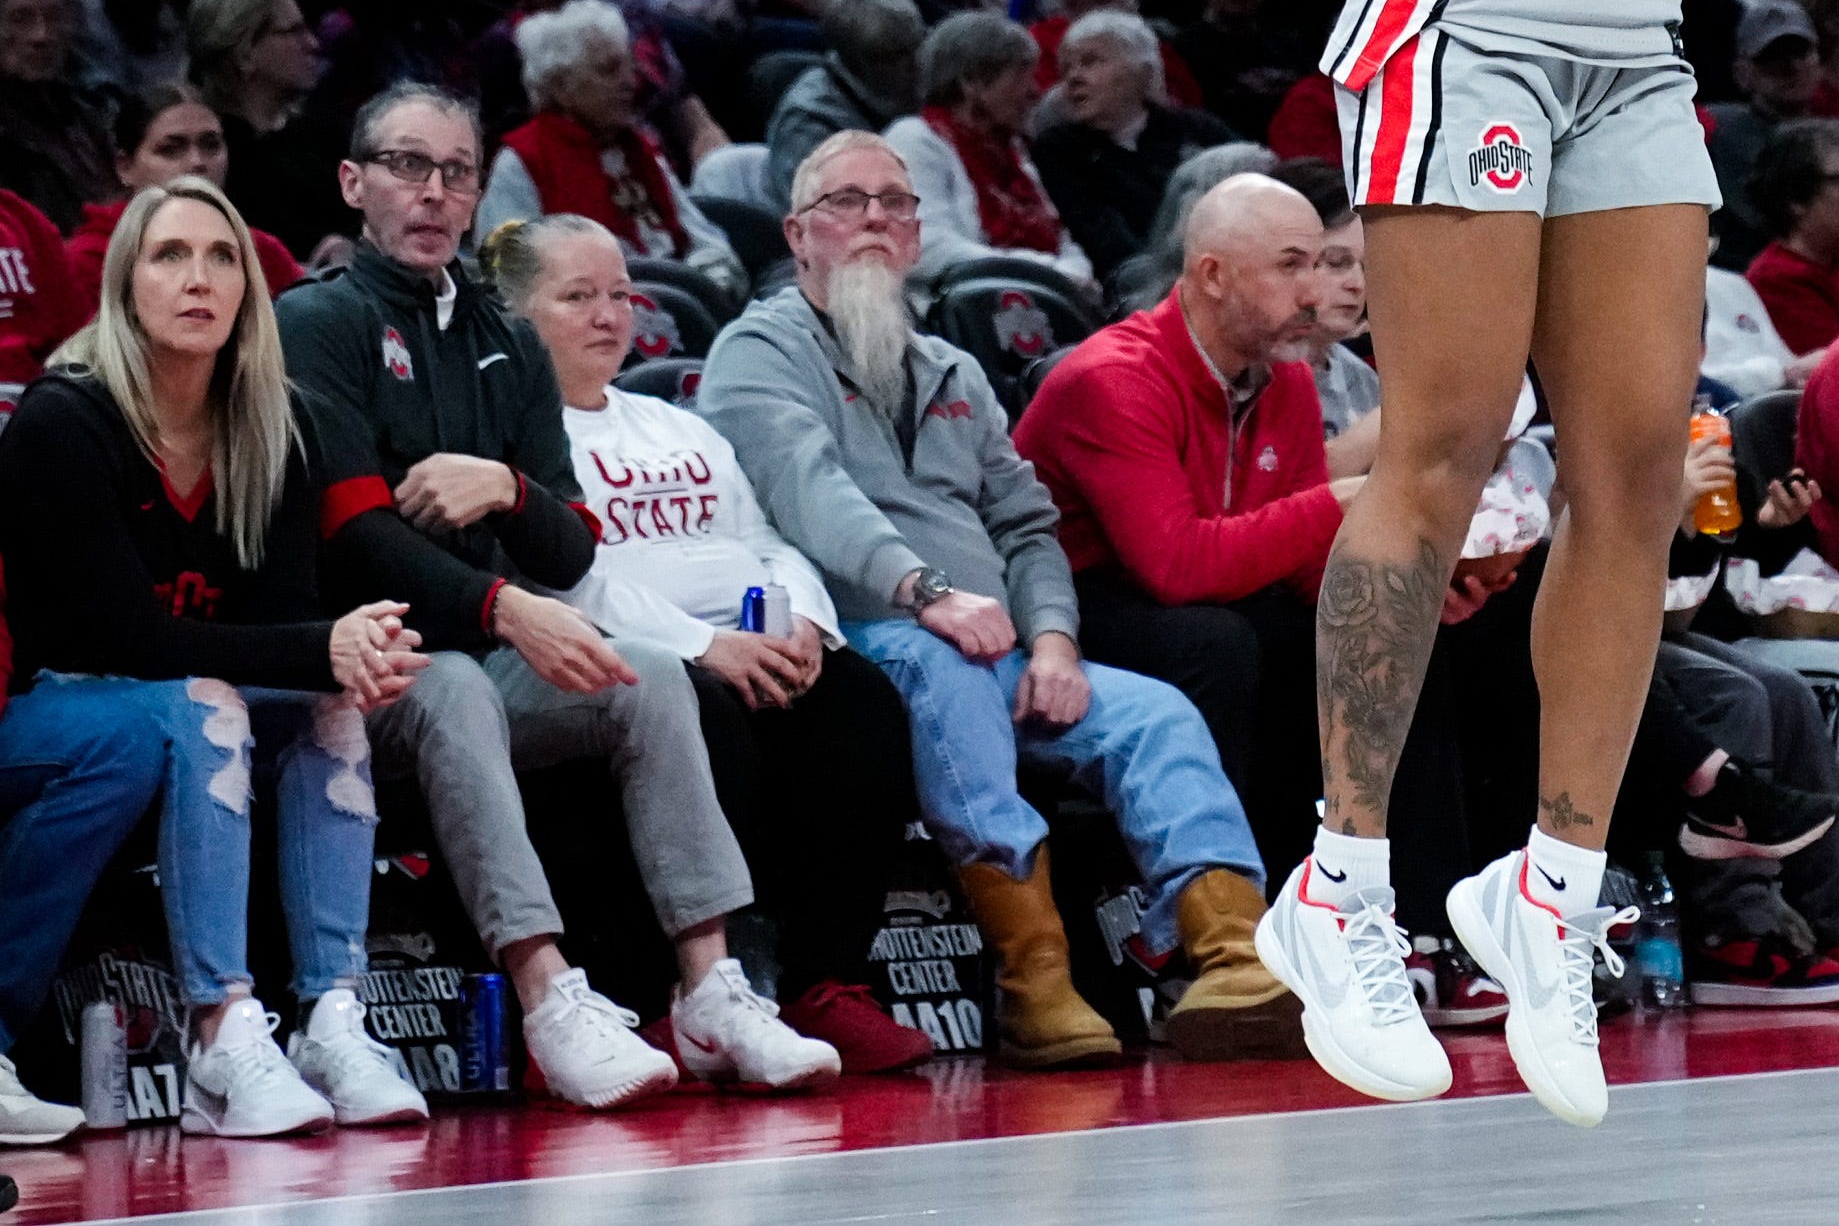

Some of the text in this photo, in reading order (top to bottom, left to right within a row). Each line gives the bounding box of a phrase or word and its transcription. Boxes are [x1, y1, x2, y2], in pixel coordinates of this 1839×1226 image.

[602, 495, 719, 546] STATE
[887, 959, 962, 996] CENTER
[368, 1003, 448, 1040] CENTER
